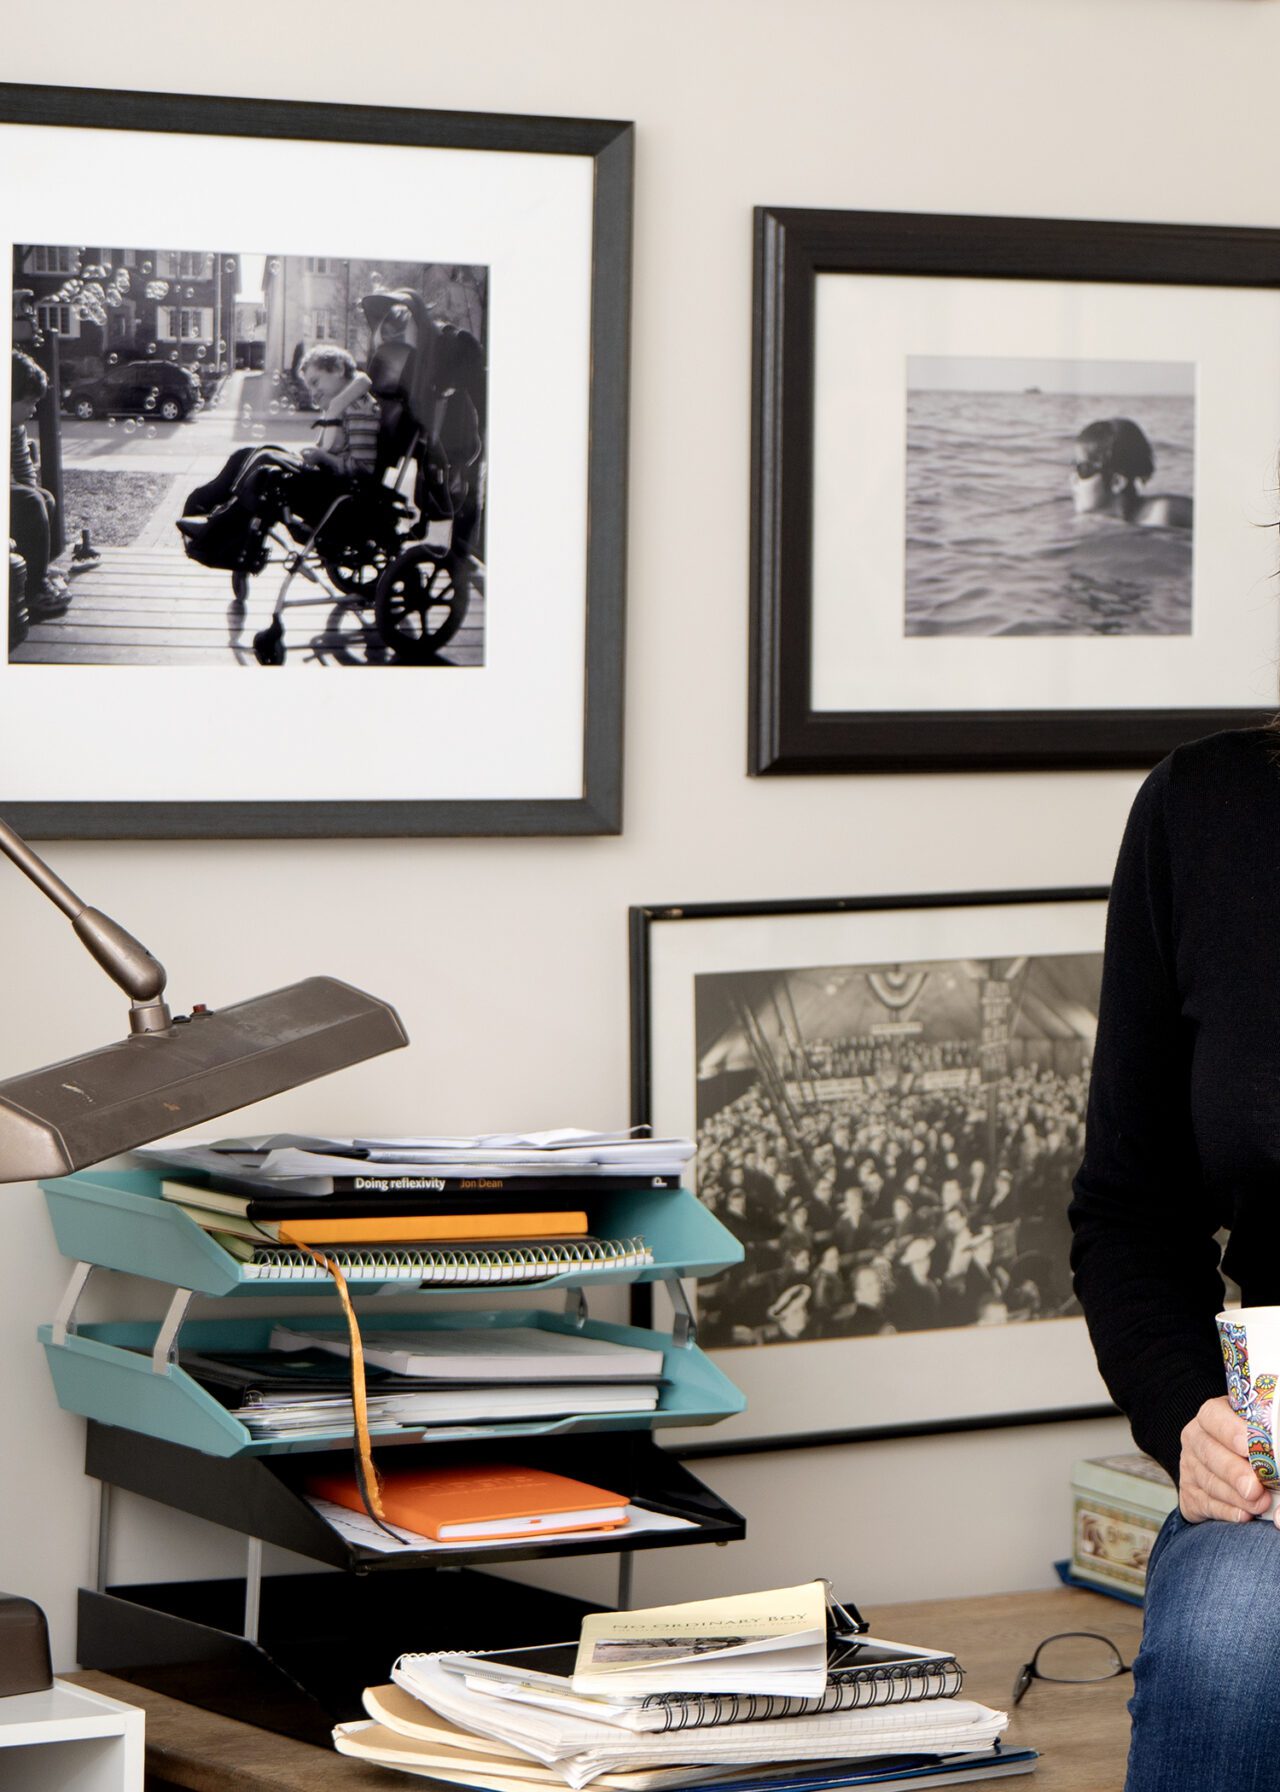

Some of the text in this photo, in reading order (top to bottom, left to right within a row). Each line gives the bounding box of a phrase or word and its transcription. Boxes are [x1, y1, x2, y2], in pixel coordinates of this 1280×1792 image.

[355, 1177, 503, 1191] Doing reflexivity Jon Dean
